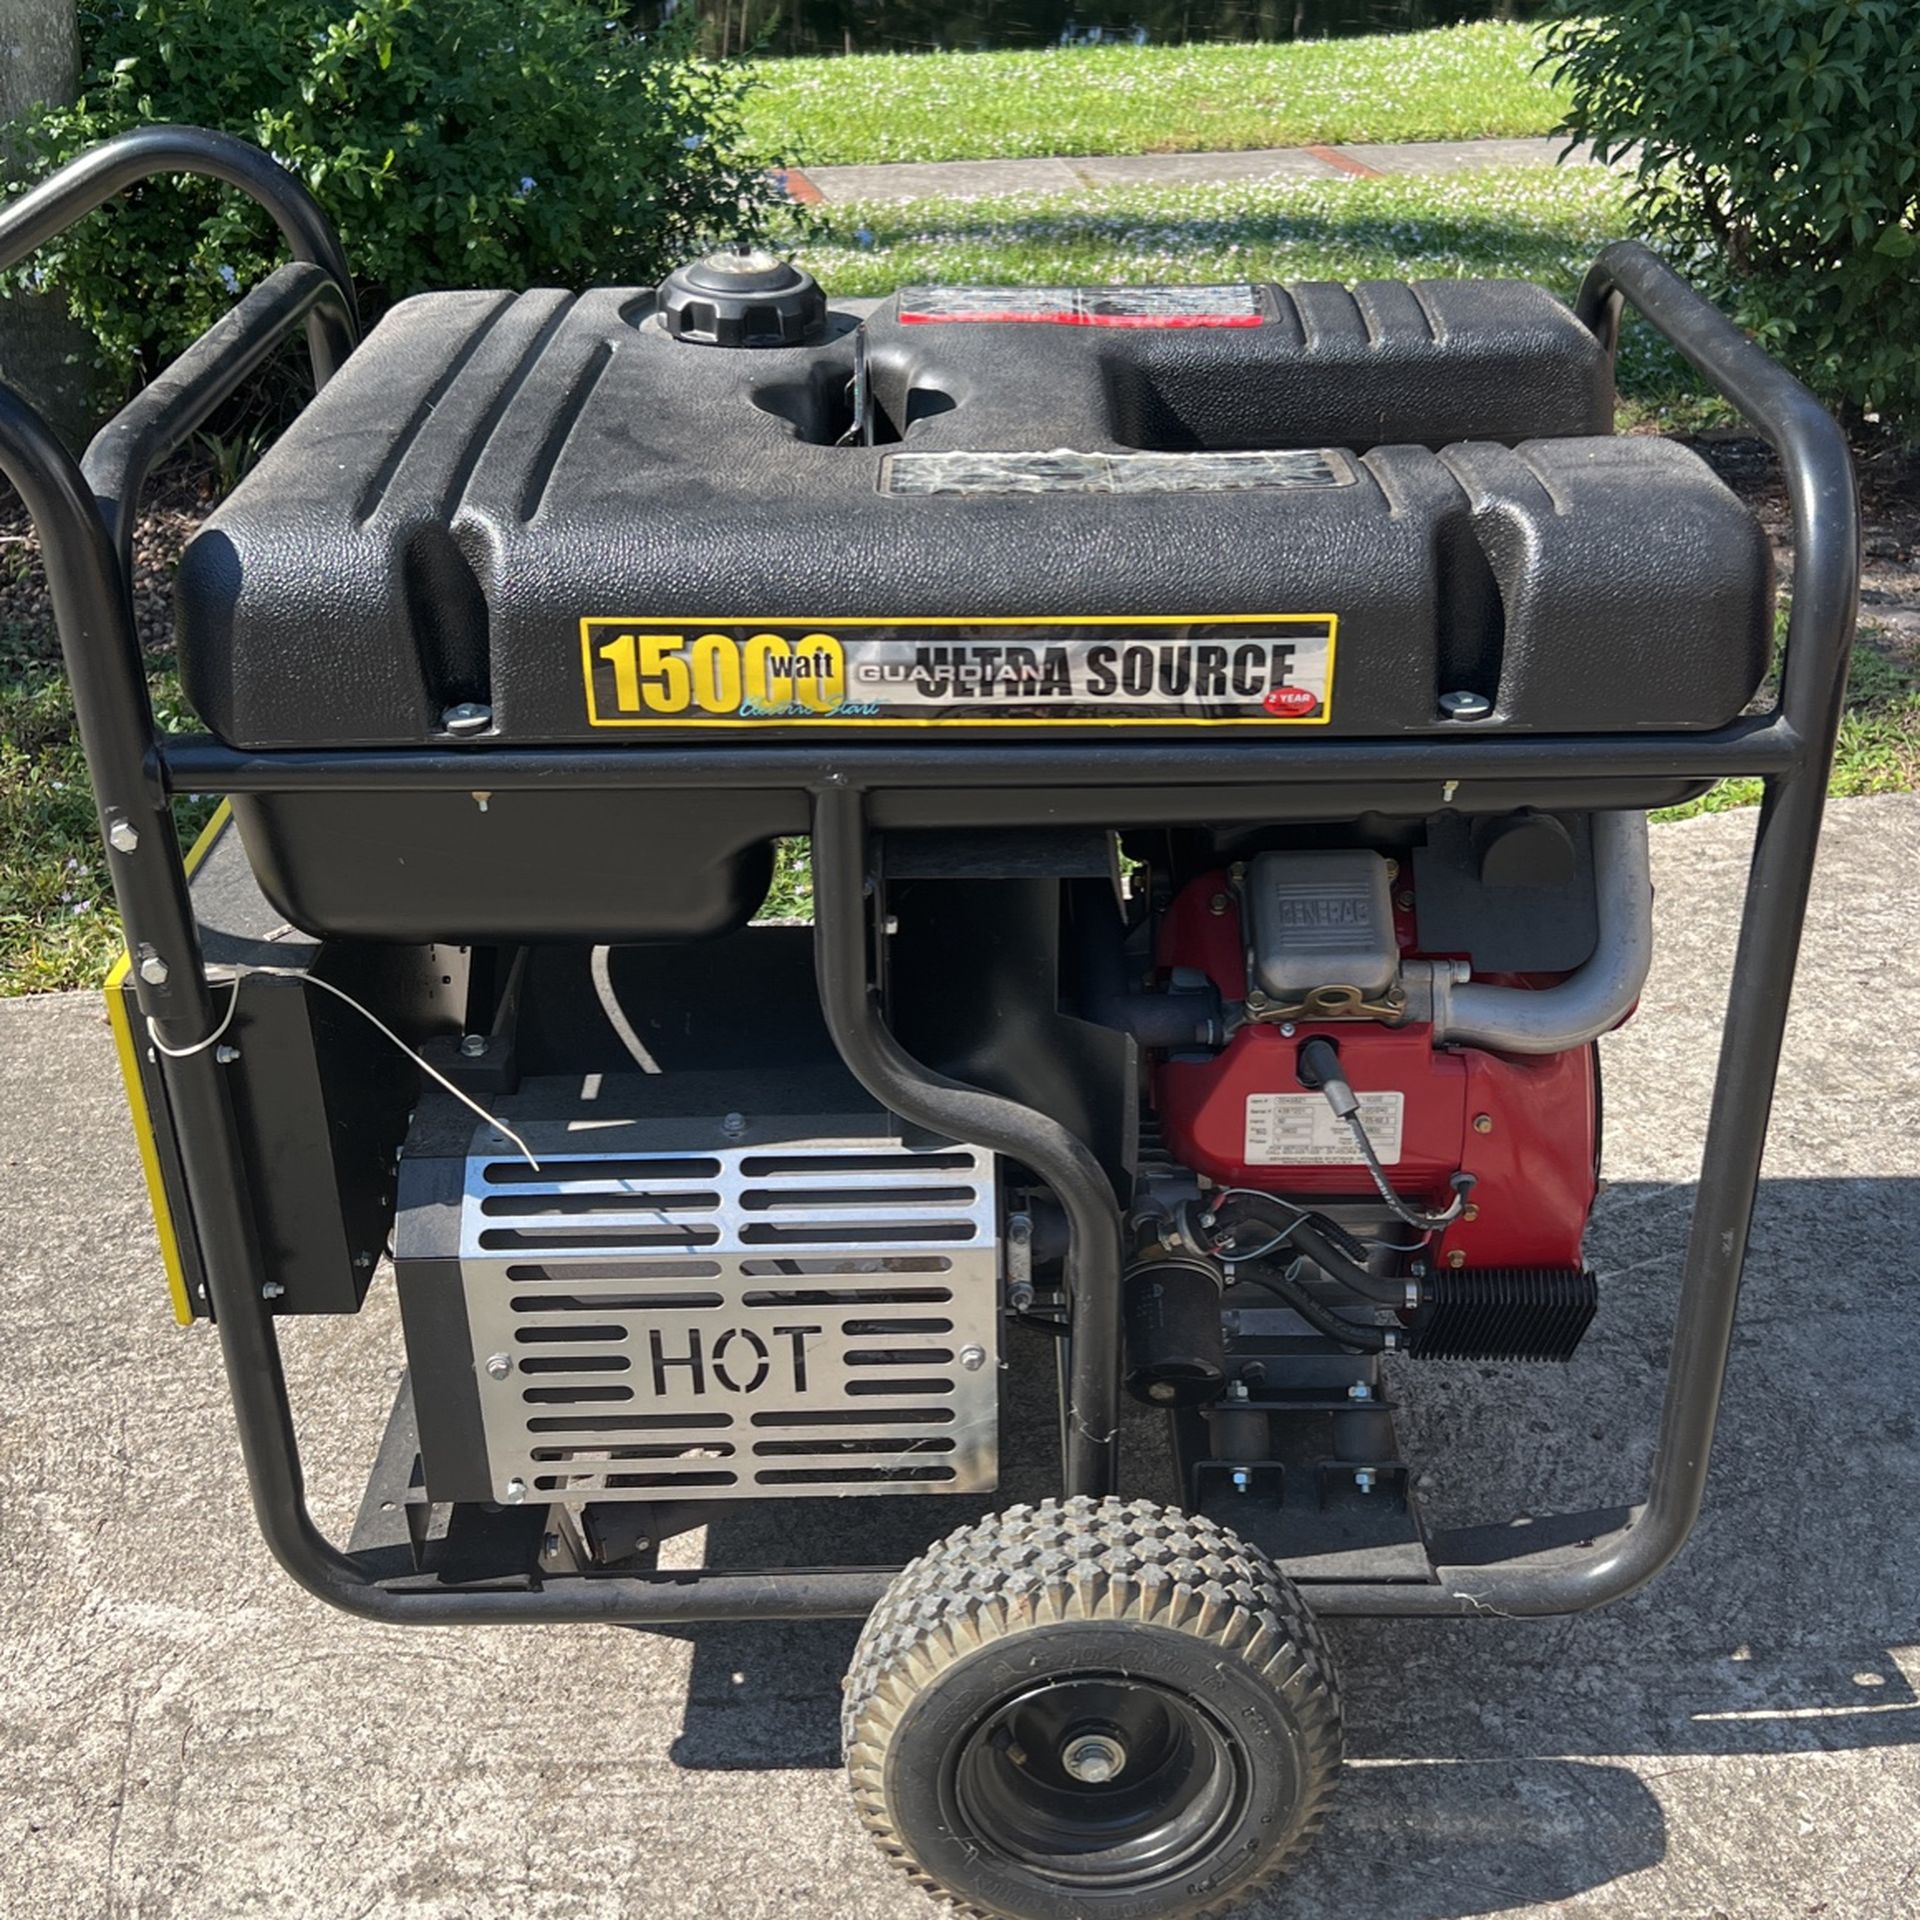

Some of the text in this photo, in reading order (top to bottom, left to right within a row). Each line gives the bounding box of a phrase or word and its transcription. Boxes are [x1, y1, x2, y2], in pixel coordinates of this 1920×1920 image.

[599, 633, 845, 713] 15000
[769, 652, 834, 679] watt
[858, 664, 1046, 682] GUARDIAN
[916, 643, 1296, 698] ULTRA SOURCE
[1268, 693, 1312, 704] 2 YEAR
[1279, 900, 1370, 927] GENERAC
[649, 1326, 822, 1396] HOT
